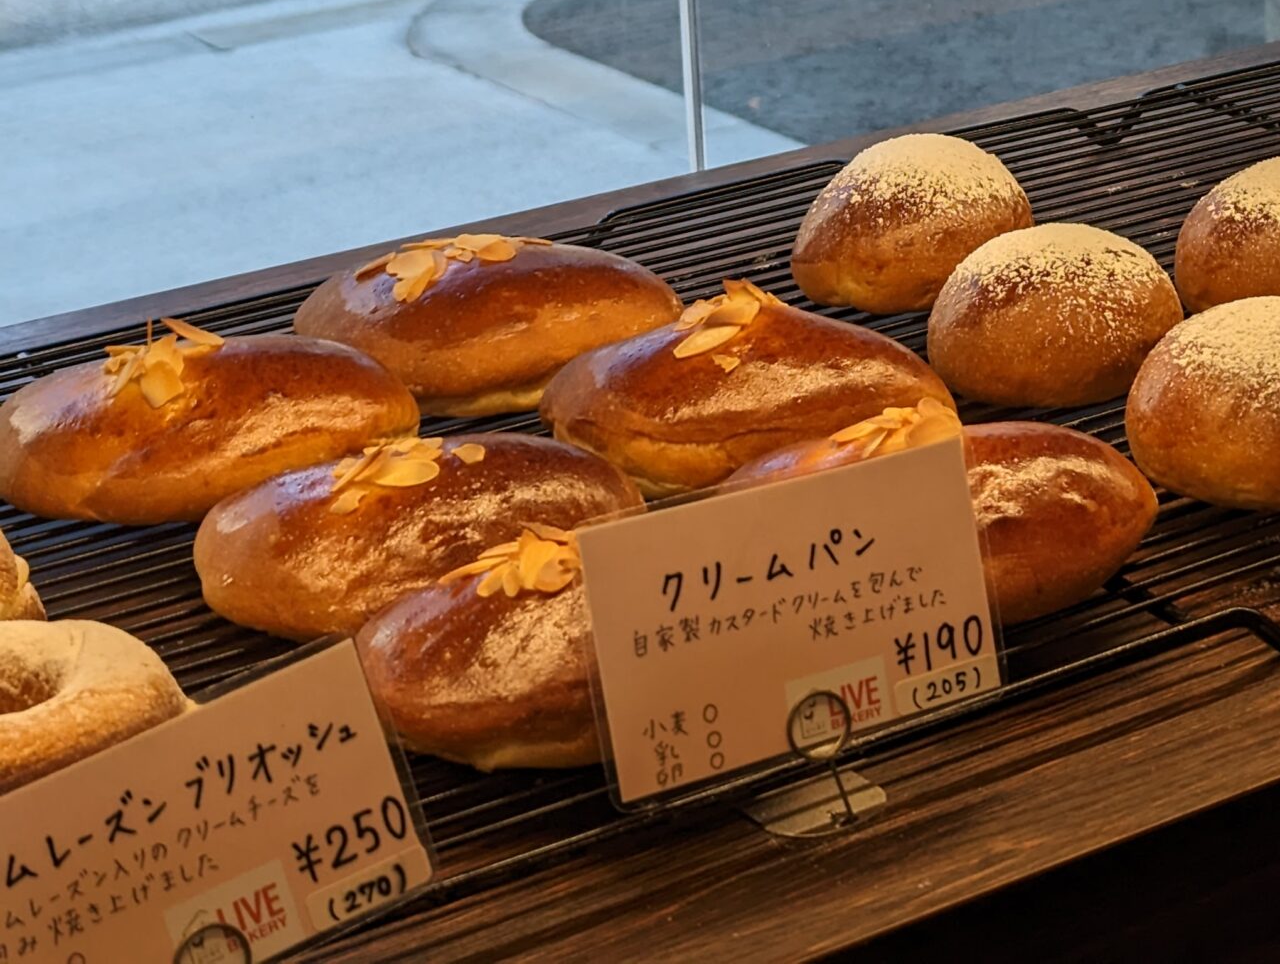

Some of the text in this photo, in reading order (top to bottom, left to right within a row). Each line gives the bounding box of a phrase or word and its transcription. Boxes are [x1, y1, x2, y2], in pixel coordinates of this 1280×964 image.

[661, 528, 876, 613] クリームパン
[894, 614, 985, 675] ¥190
[912, 666, 982, 709] (205)
[292, 795, 408, 885] ¥250
[327, 863, 408, 922] (270)
